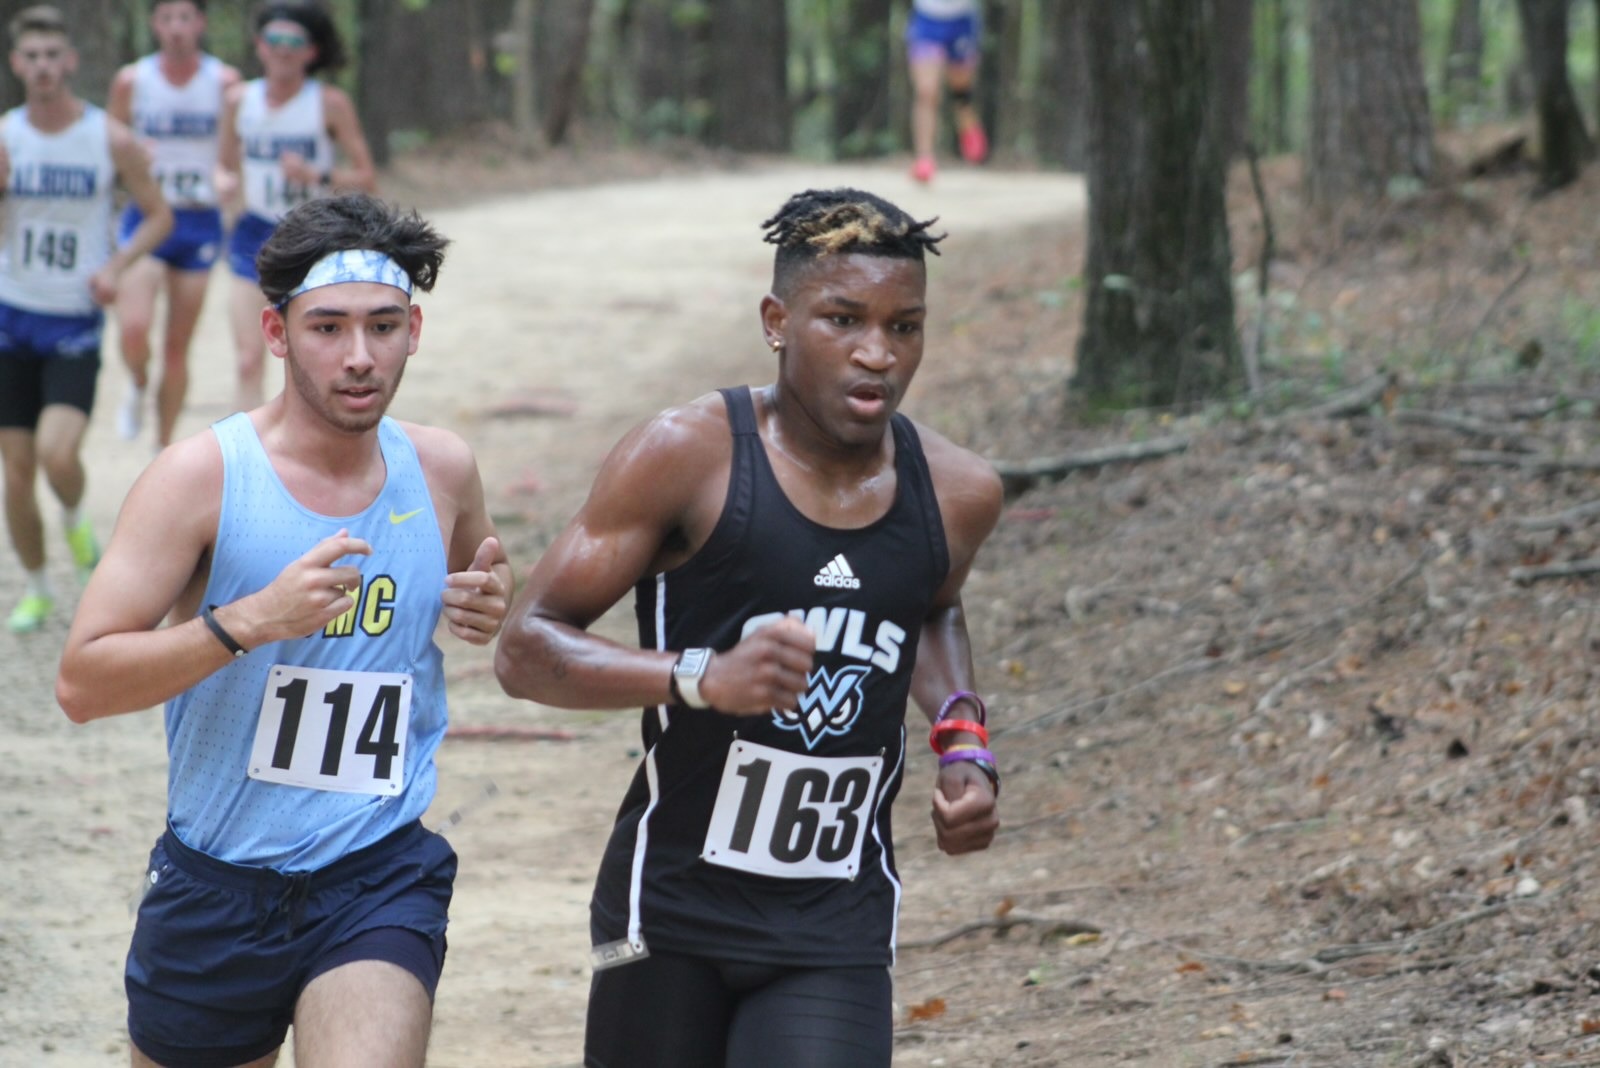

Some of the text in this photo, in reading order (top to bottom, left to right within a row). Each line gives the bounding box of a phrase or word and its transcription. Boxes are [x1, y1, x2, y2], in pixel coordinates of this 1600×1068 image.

[23, 229, 77, 269] 149
[305, 574, 397, 638] MC
[814, 574, 861, 589] adidas
[271, 678, 402, 780] 114
[729, 758, 871, 863] 163
